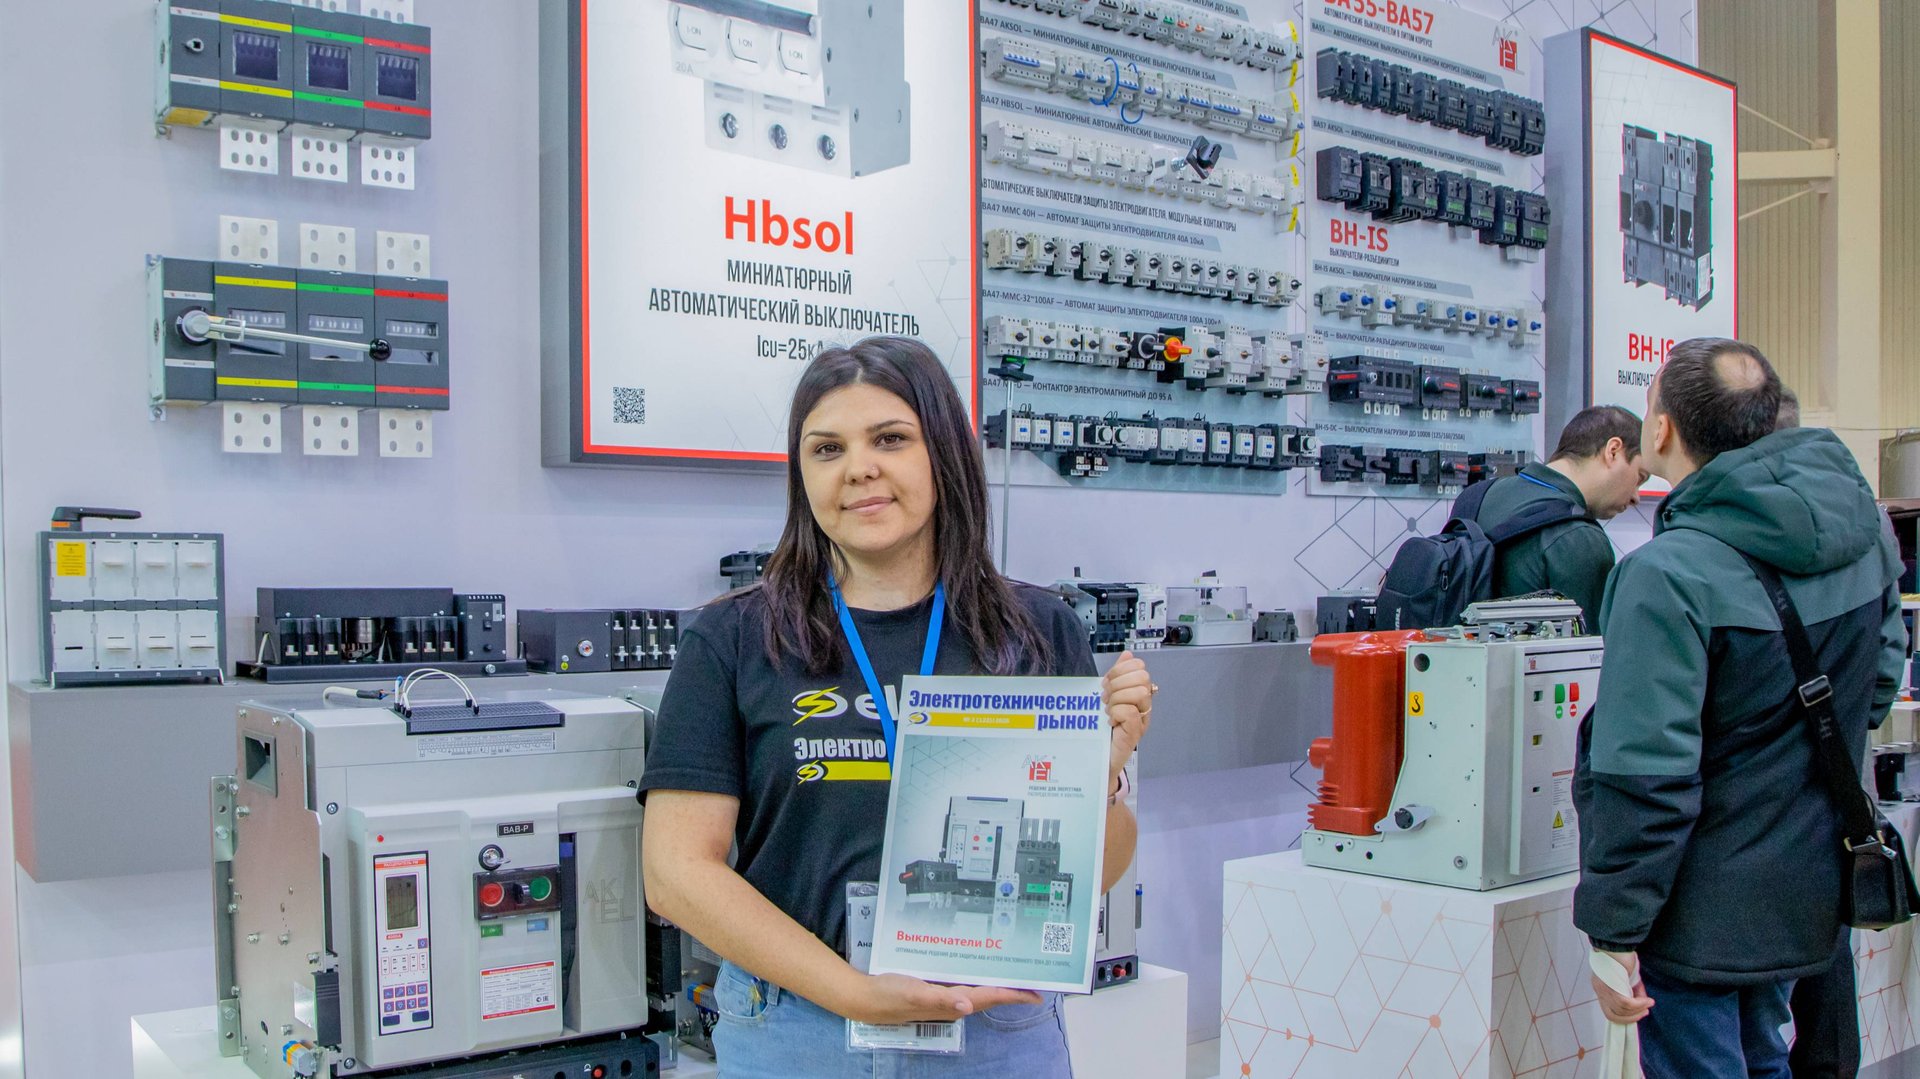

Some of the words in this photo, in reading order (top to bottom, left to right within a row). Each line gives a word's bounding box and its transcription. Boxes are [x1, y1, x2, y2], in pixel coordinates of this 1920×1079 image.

[1000, 20, 1022, 33] AKSOL
[1034, 28, 1089, 50] МИНИАТЮРНЫЕ
[1090, 43, 1152, 64] АВТОМАТИЧЕСКИЕ
[1152, 56, 1200, 78] ВЫКЛЮЧАТЕЛИ
[1202, 70, 1216, 81] 15кА
[1334, 30, 1379, 48] АВТОМАТИЧЕСКИЕ
[1380, 43, 1418, 60] ВЫКЛЮЧАТЕЛИ
[1001, 98, 1024, 111] HBSOL
[1034, 106, 1090, 125] МИНИАТЮРНЫЕ
[1092, 118, 1152, 138] АВТОМАТИЧЕСКИЕ
[1351, 130, 1396, 146] АВТОМАТИЧЕСКИЕ
[1036, 187, 1082, 205] ВЫКЛЮЧАТЕЛИ
[1083, 196, 1108, 208] ЗАЩИТЫ
[1168, 212, 1202, 225] МОДУЛЬНЫЕ
[1204, 217, 1236, 232] КОНТАКТОРЫ
[725, 196, 854, 256] Hbsol
[1046, 212, 1078, 224] АВТОМАТ
[1080, 218, 1110, 230] ЗАЩИТЫ
[1112, 222, 1176, 240] ЭЛЕКТРОДВИГАТЕЛЯ
[1330, 247, 1400, 266] ВЫКЛЮЧАТЕЛИ-РАЗЪЕДИНИТЕЛИ
[727, 259, 852, 295] МИНИАТЮРНЫЙ
[1352, 270, 1391, 282] ВЫКЛЮЧАТЕЛИ
[1392, 276, 1416, 286] НАГРУЗКИ
[649, 287, 800, 325] АВТОМАТИЧЕСКИЙ
[804, 304, 920, 336] ВЫКЛЮЧАТЕЛЬ
[1064, 300, 1096, 310] АВТОМАТ
[1097, 303, 1126, 314] ЗАЩИТЫ
[1127, 306, 1188, 322] ЭЛЕКТРОДВИГАТЕЛЯ
[1336, 332, 1418, 350] ВЫКЛЮЧАТЕЛИ-РАЗЪЕДИНИТЕЛИ
[1032, 382, 1073, 393] КОНТАКТОР
[1074, 386, 1146, 400] ЭЛЕКТРОМАГНИТНЫЙ
[1148, 392, 1158, 400] ДО
[1158, 392, 1168, 400] 95
[1344, 426, 1383, 435] ВЫКЛЮЧАТЕЛИ
[909, 690, 1100, 711] Электротехнический
[1038, 714, 1098, 731] рынок
[794, 736, 886, 760] Электро
[896, 930, 982, 948] Выключатели
[986, 938, 1002, 950] DC
